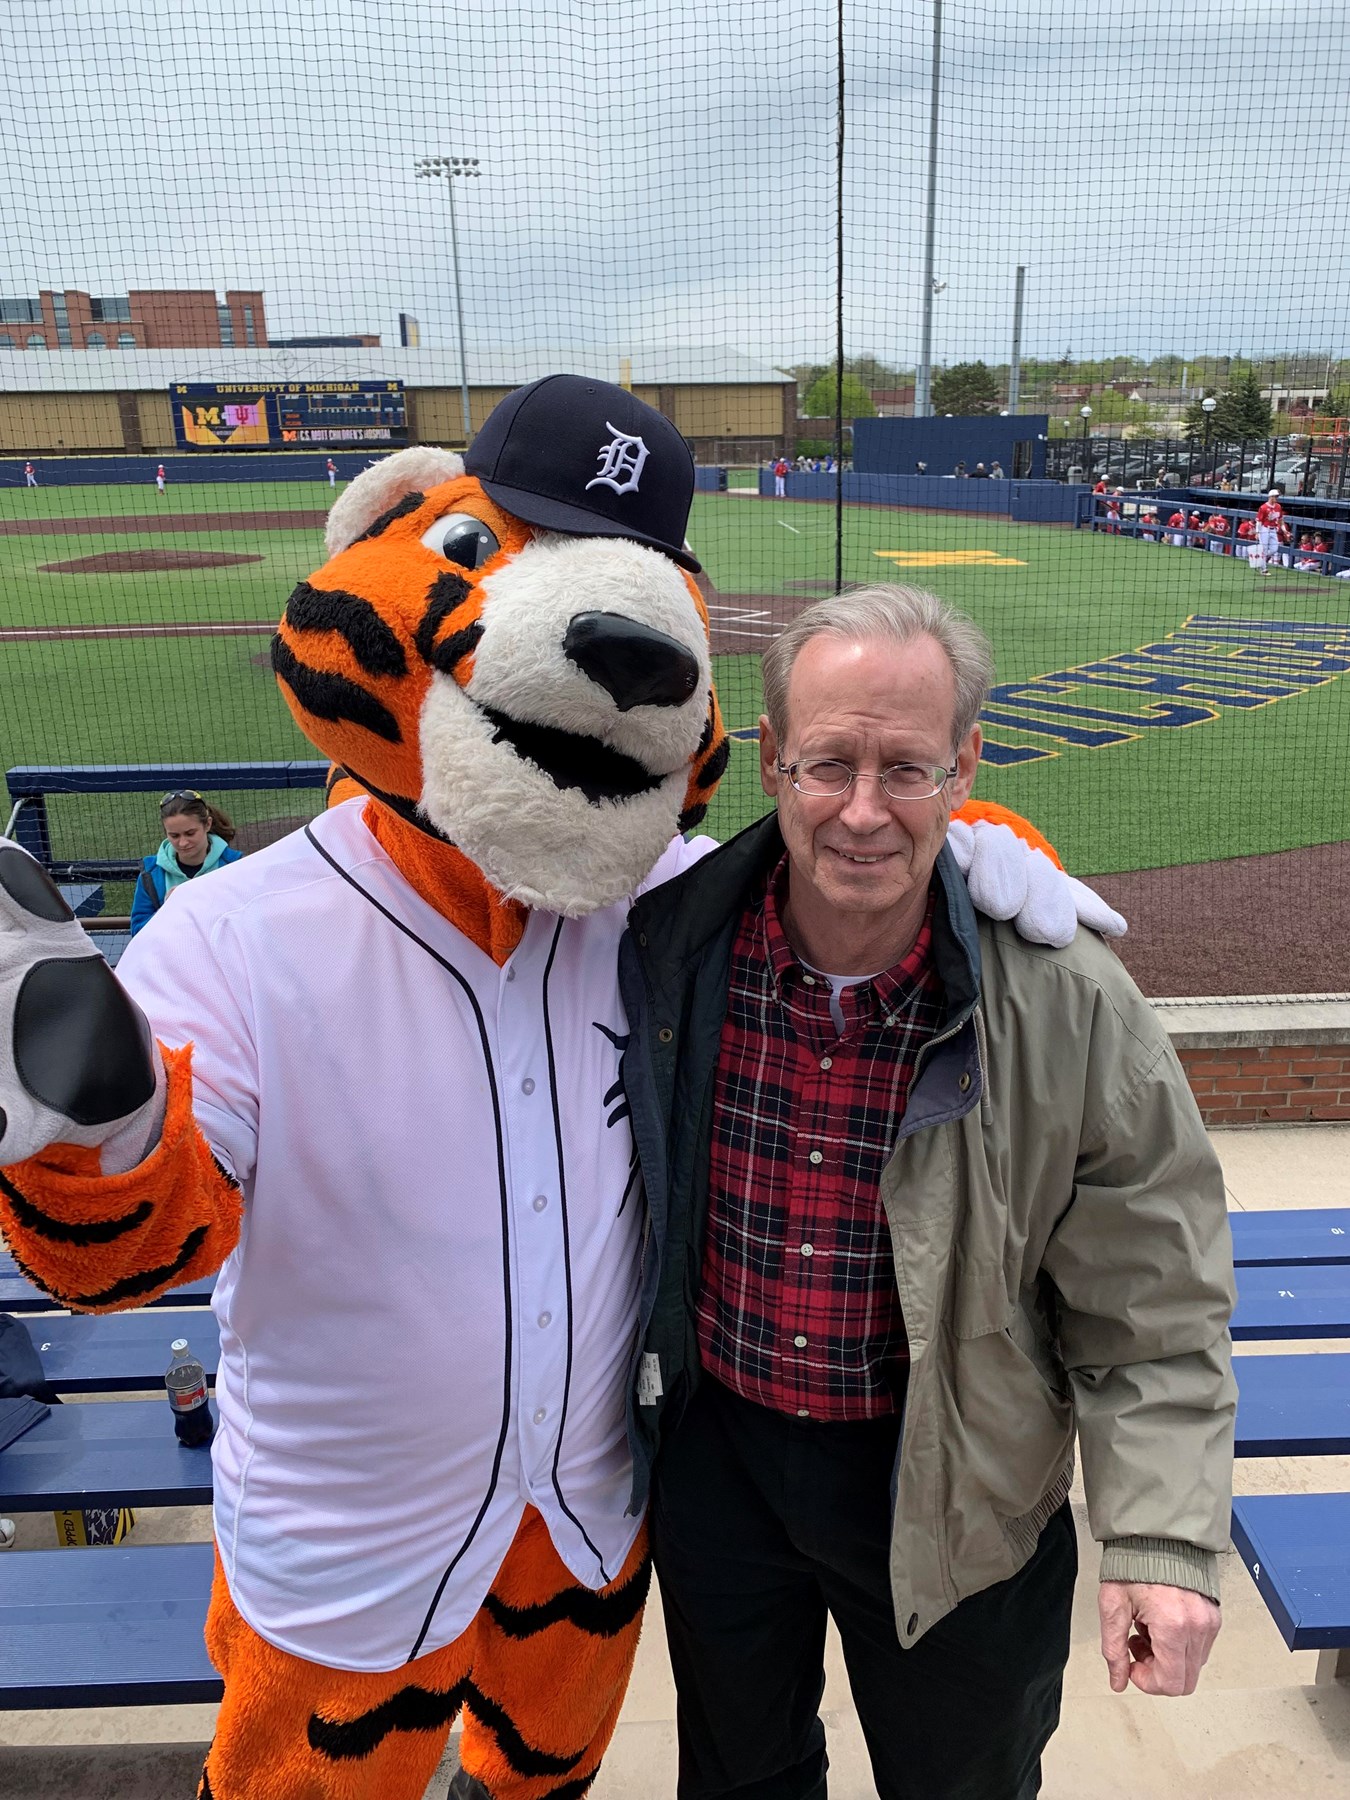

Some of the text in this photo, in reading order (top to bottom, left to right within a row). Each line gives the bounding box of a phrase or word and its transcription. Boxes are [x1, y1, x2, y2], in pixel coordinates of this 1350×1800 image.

[216, 383, 359, 393] UNIVERSITY OF MICHIGAN
[195, 407, 220, 425] M
[585, 421, 650, 496] D
[975, 614, 1350, 768] ICHIGAN
